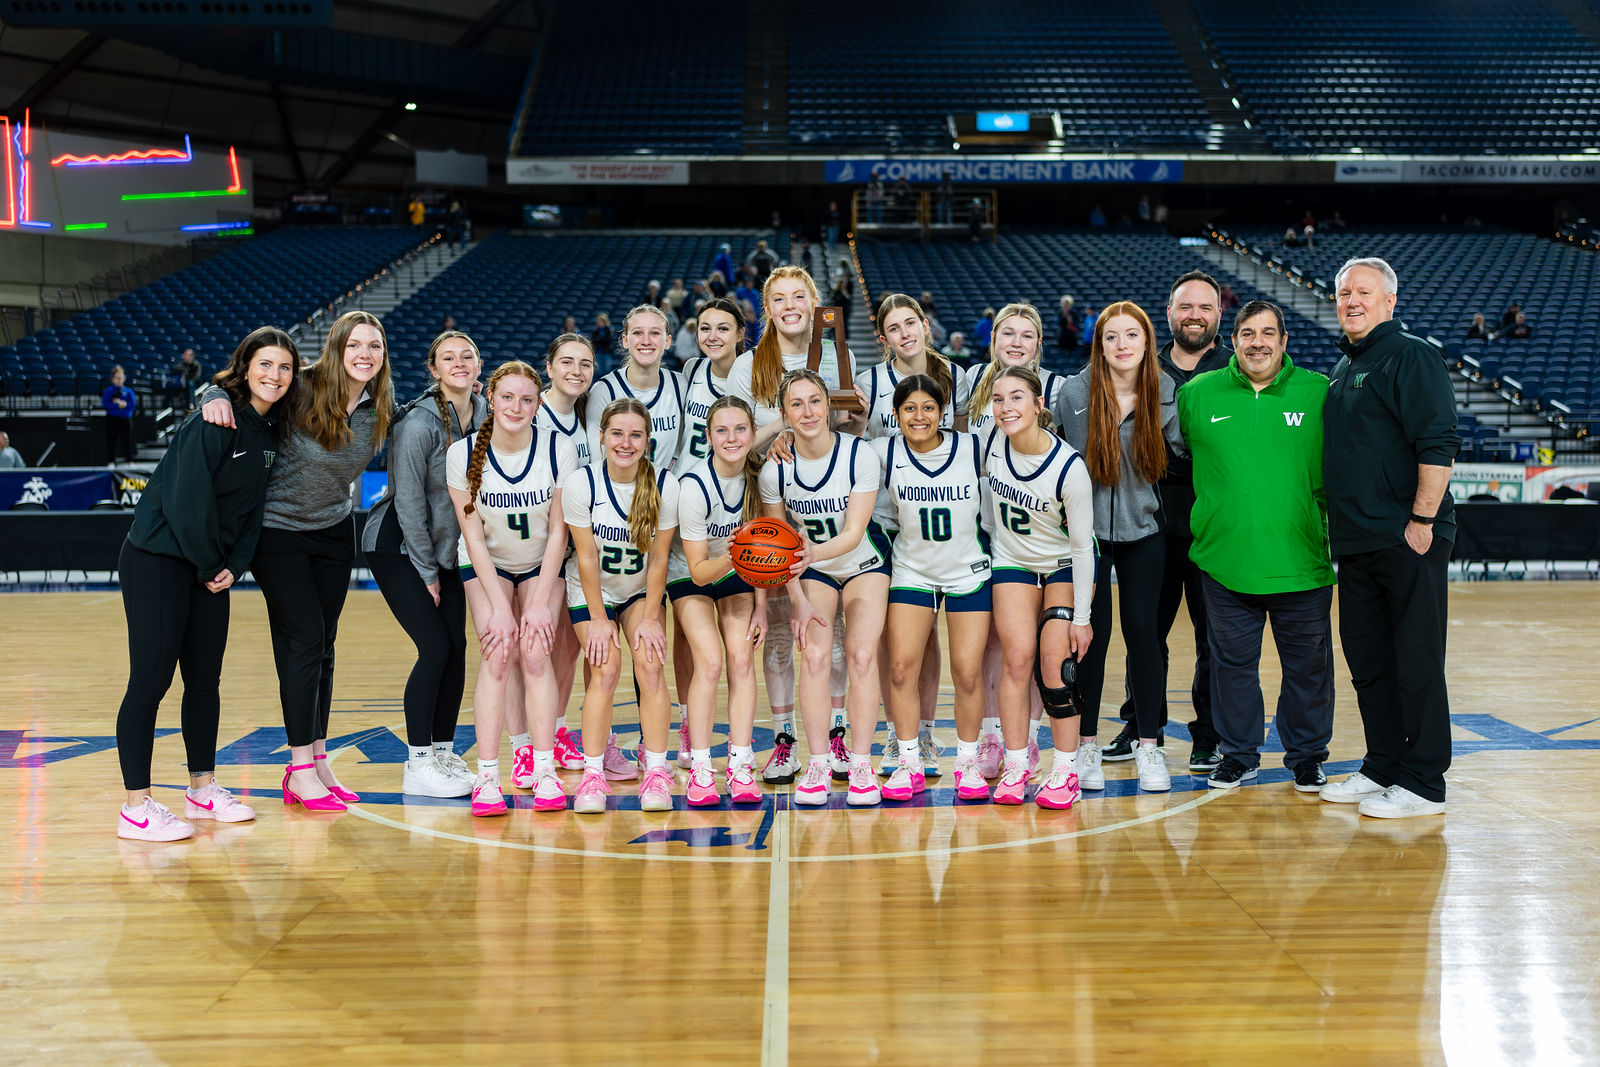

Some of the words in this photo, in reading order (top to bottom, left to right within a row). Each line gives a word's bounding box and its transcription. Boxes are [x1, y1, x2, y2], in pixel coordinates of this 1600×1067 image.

[872, 162, 1066, 181] COMMENCEMENT
[1072, 162, 1135, 180] BANK
[1420, 165, 1596, 178] TACOMASUBARU.COM
[1282, 411, 1304, 427] W
[479, 486, 552, 508] WOODINVILLE
[898, 484, 970, 501] WOODINVILLE
[988, 471, 1050, 512] WOODINVILLE
[785, 495, 849, 514] WOODINVILLE
[506, 512, 530, 540] 4
[919, 507, 953, 542] 10
[999, 501, 1031, 535] 12
[803, 517, 838, 544] 21
[601, 545, 644, 575] 23
[739, 548, 788, 565] Baden
